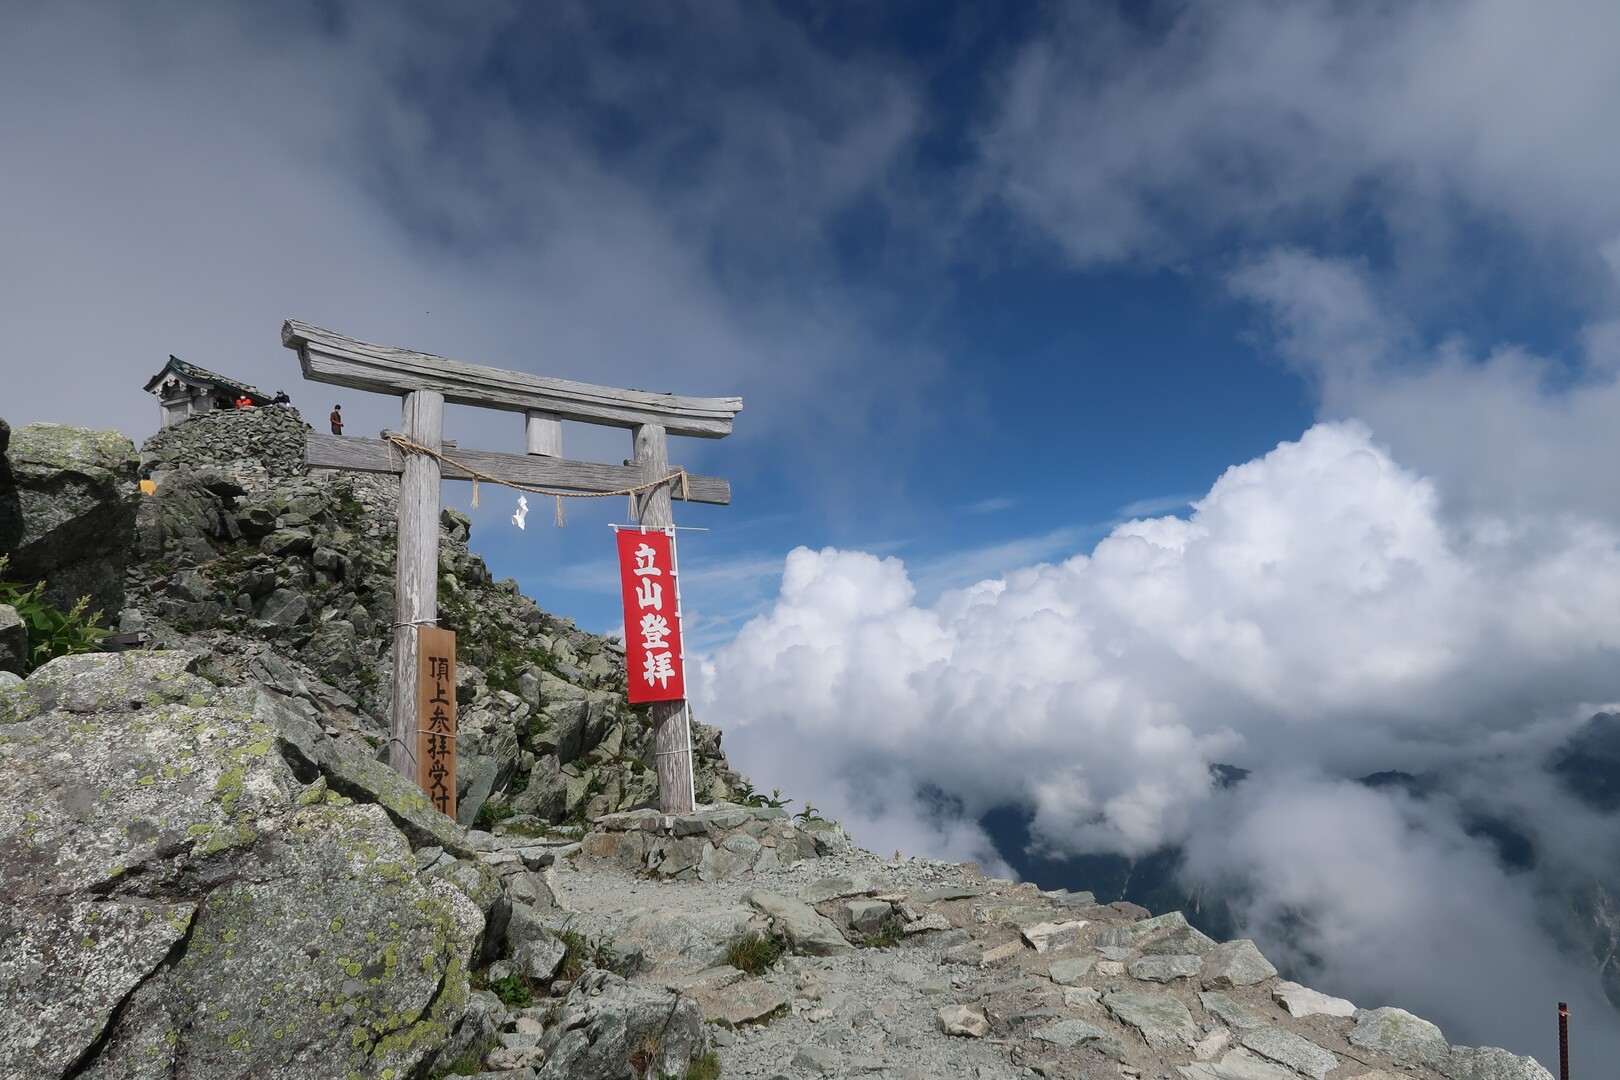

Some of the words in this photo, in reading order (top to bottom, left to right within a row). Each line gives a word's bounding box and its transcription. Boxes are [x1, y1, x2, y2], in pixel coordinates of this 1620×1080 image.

[633, 543, 676, 690] 立山登拝
[427, 656, 451, 814] 頂上参拝受付
